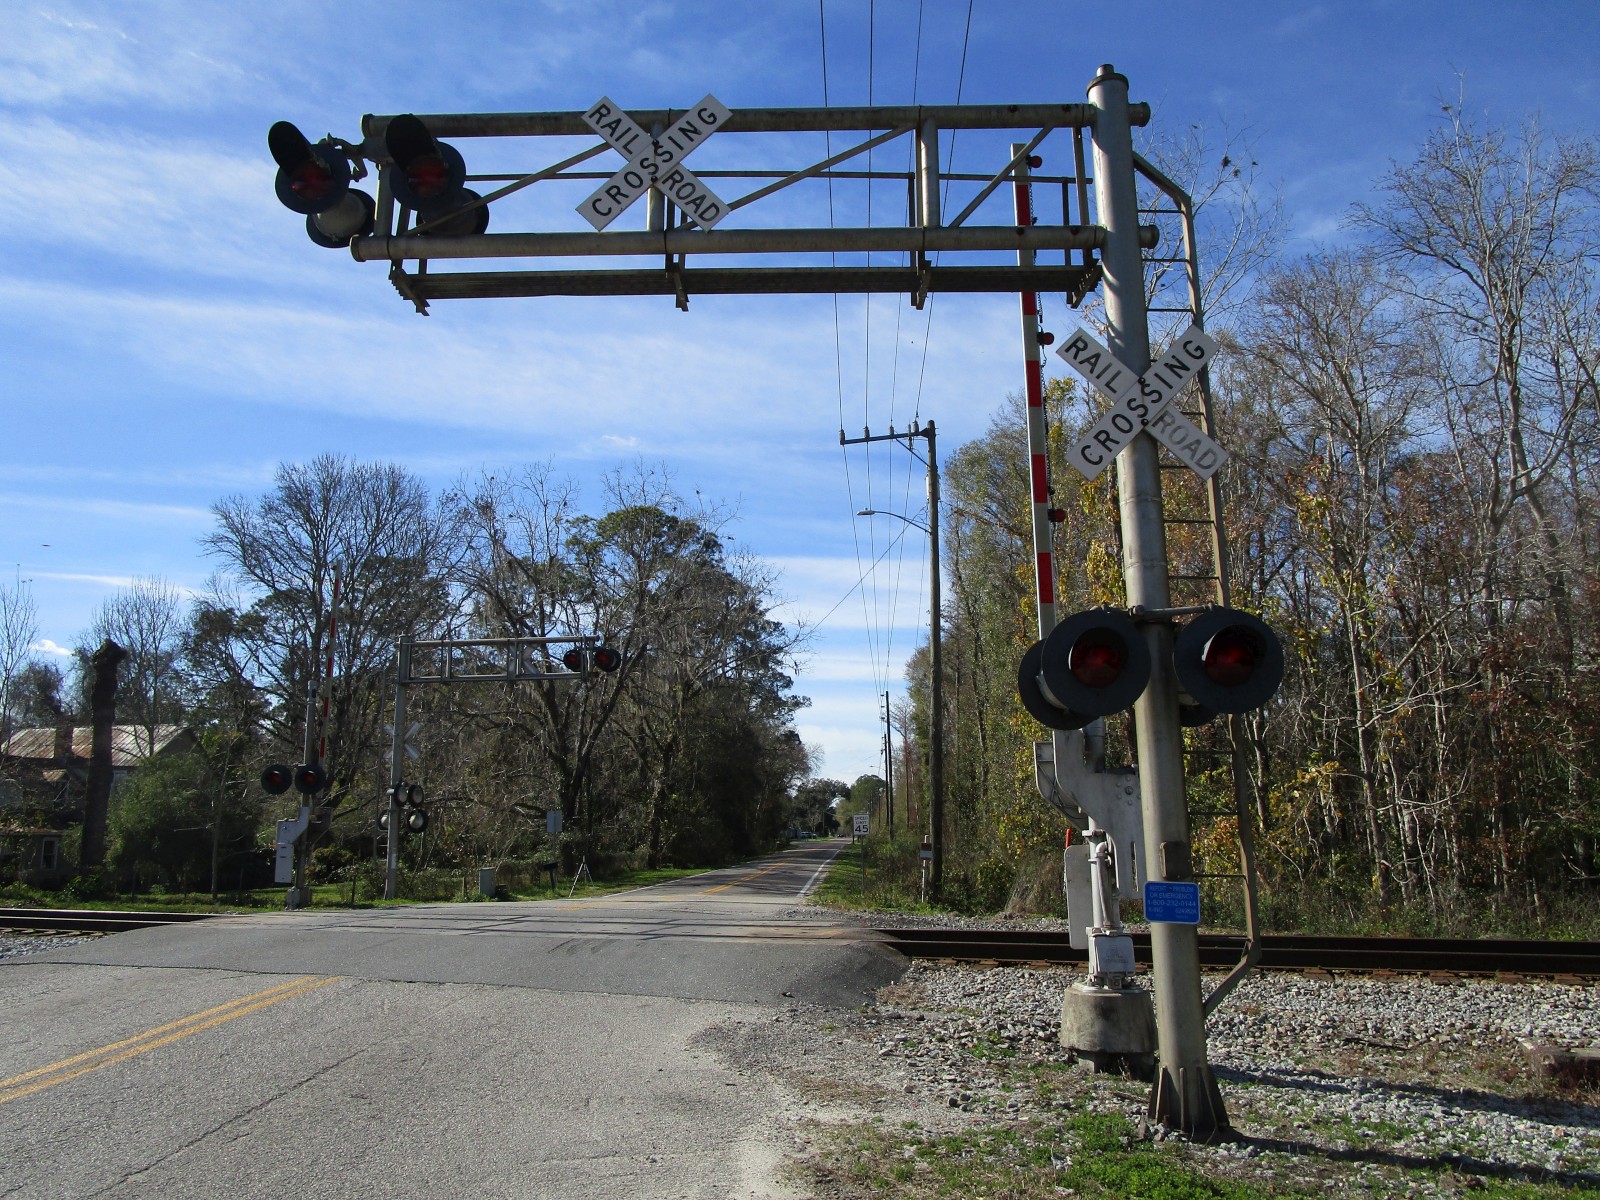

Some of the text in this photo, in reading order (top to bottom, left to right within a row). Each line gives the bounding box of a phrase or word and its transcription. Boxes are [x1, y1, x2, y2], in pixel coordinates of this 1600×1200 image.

[588, 103, 720, 223] RAIL ROAD
[591, 107, 718, 217] CROSSING
[1064, 335, 1220, 470] RAIL ROAD
[1080, 340, 1205, 466] CROSSING
